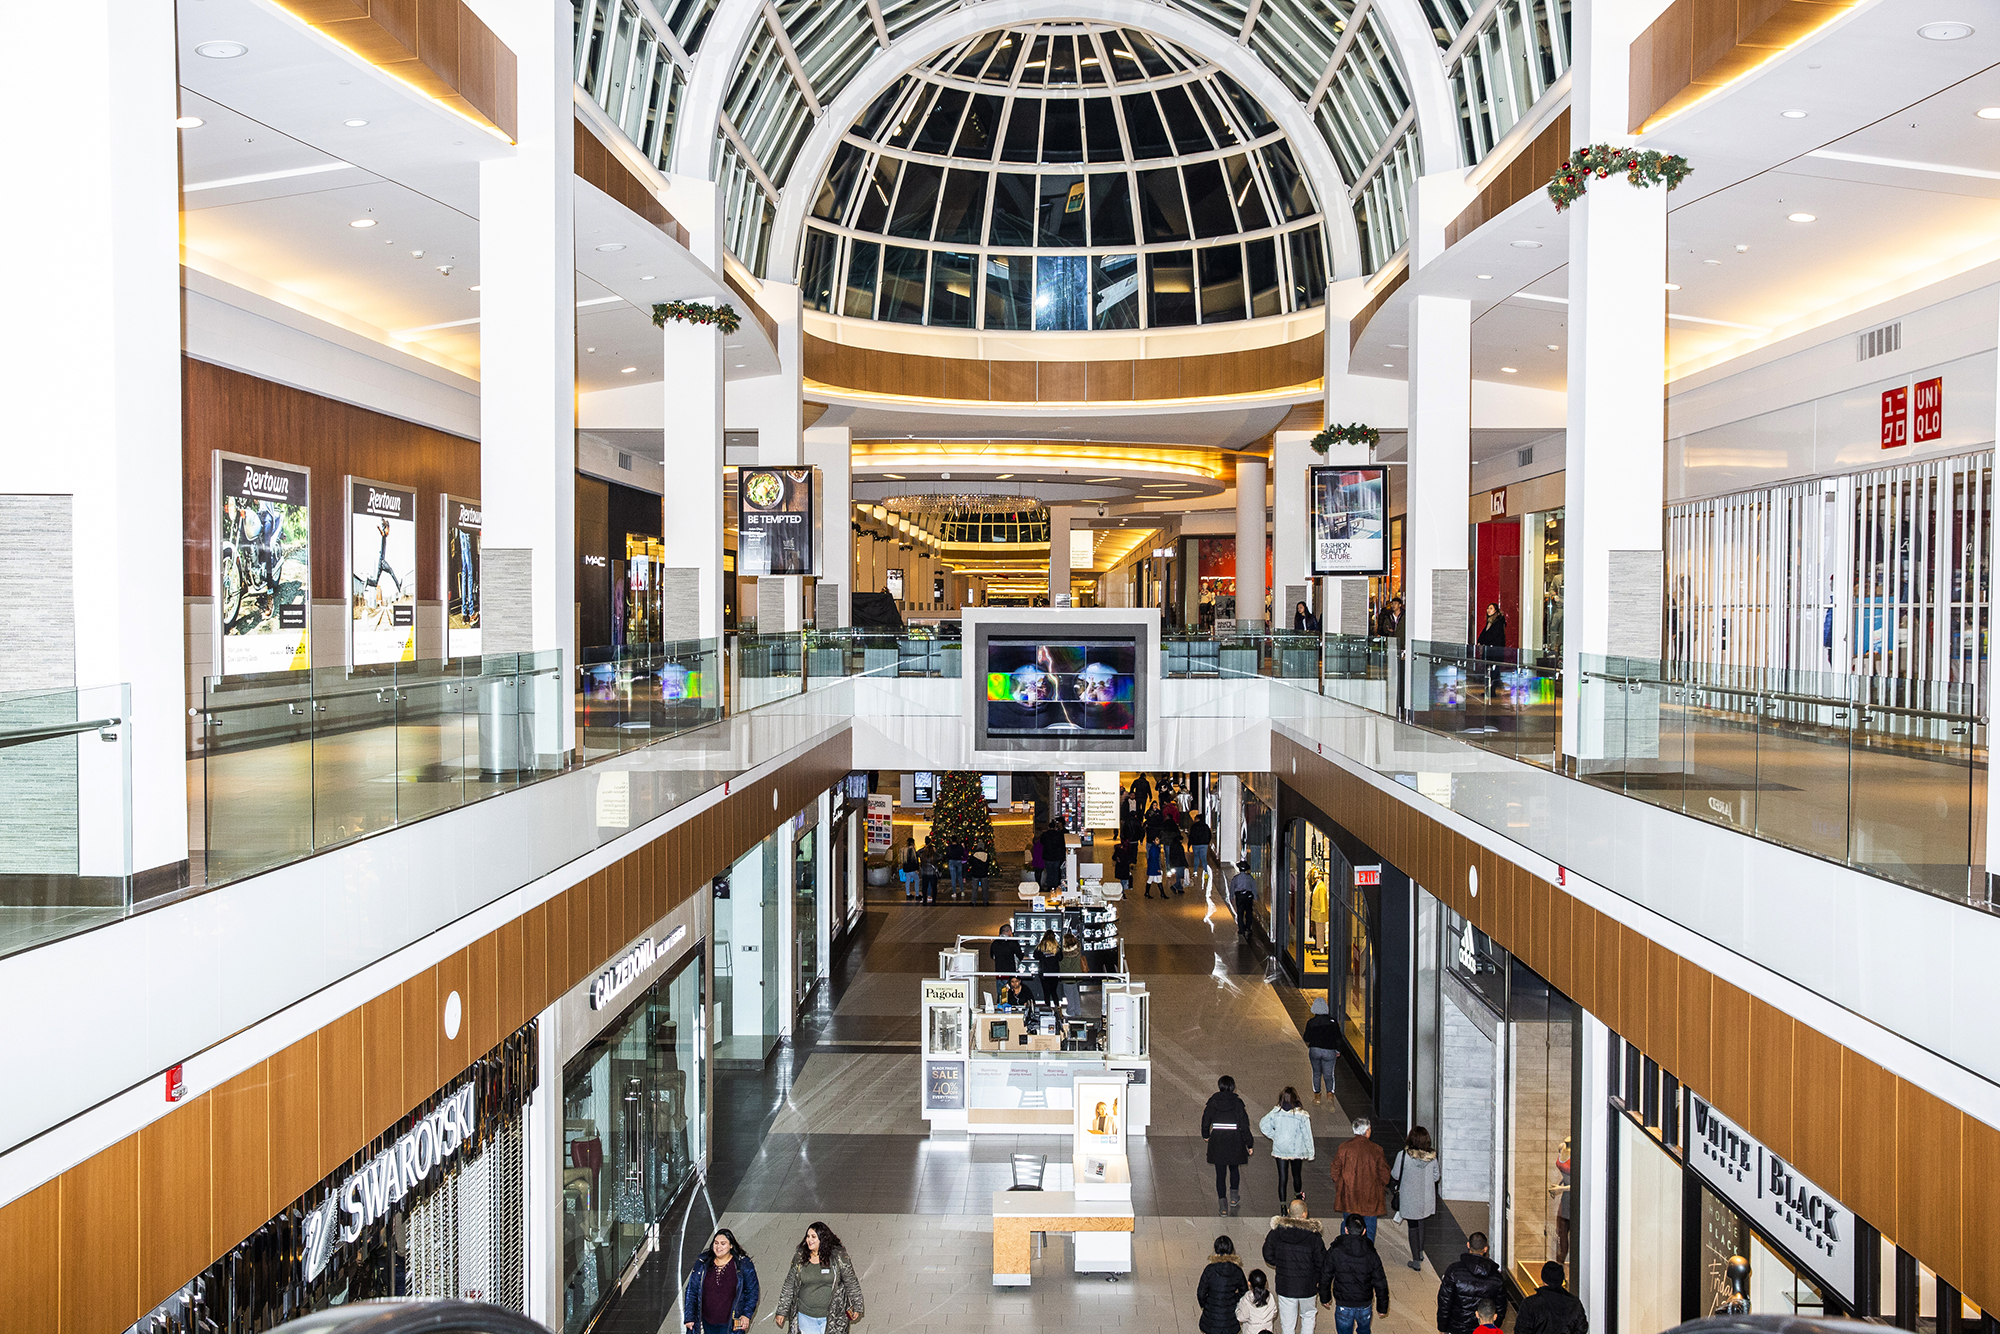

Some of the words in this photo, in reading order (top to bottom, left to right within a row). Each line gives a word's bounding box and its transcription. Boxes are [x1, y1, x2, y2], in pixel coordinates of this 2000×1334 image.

[1884, 393, 1905, 418] ユニ
[1917, 385, 1938, 410] UNI
[1883, 420, 1905, 443] クロ
[1916, 411, 1940, 439] QLO
[242, 466, 289, 497] Revtown
[367, 487, 401, 513] Revtown
[748, 515, 759, 524] BE
[760, 515, 802, 524] TEMPTED
[1358, 870, 1377, 883] EXIT
[592, 936, 656, 1012] CALZEDONIA
[1458, 947, 1476, 975] adidas
[926, 988, 964, 1001] Pagoda
[932, 1070, 958, 1079] SALE
[343, 1081, 476, 1244] SWAROVSKI
[1693, 1096, 1752, 1172] WHITE
[1769, 1154, 1841, 1243] BLACK
[1703, 1142, 1744, 1182] HOUSE
[1775, 1201, 1834, 1258] MARKET
[1708, 1204, 1738, 1239] HOUSE
[1708, 1222, 1738, 1256] BLACK
